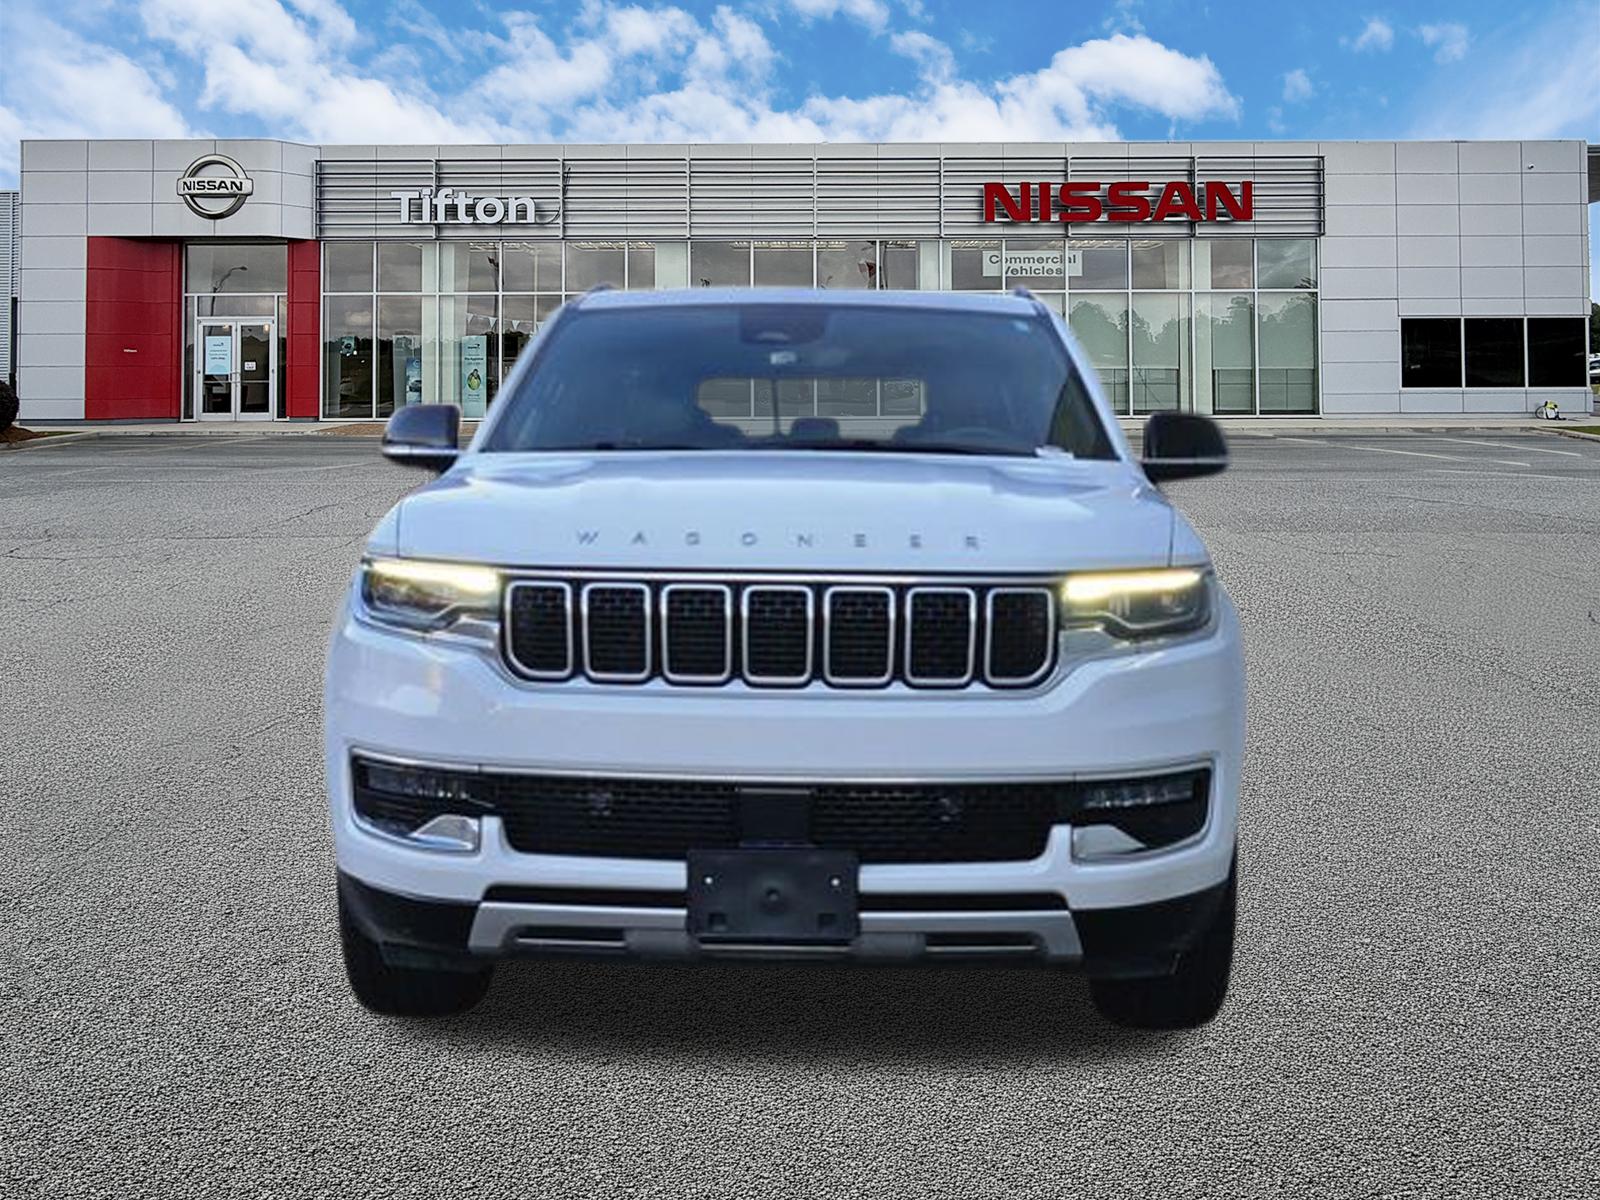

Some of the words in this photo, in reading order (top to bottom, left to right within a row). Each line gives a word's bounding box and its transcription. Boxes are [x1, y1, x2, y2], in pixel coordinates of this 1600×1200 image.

[182, 180, 243, 192] NISSAN
[390, 188, 536, 224] Tifton
[983, 181, 1254, 223] NISSAN
[576, 530, 981, 551] WAGONEER
